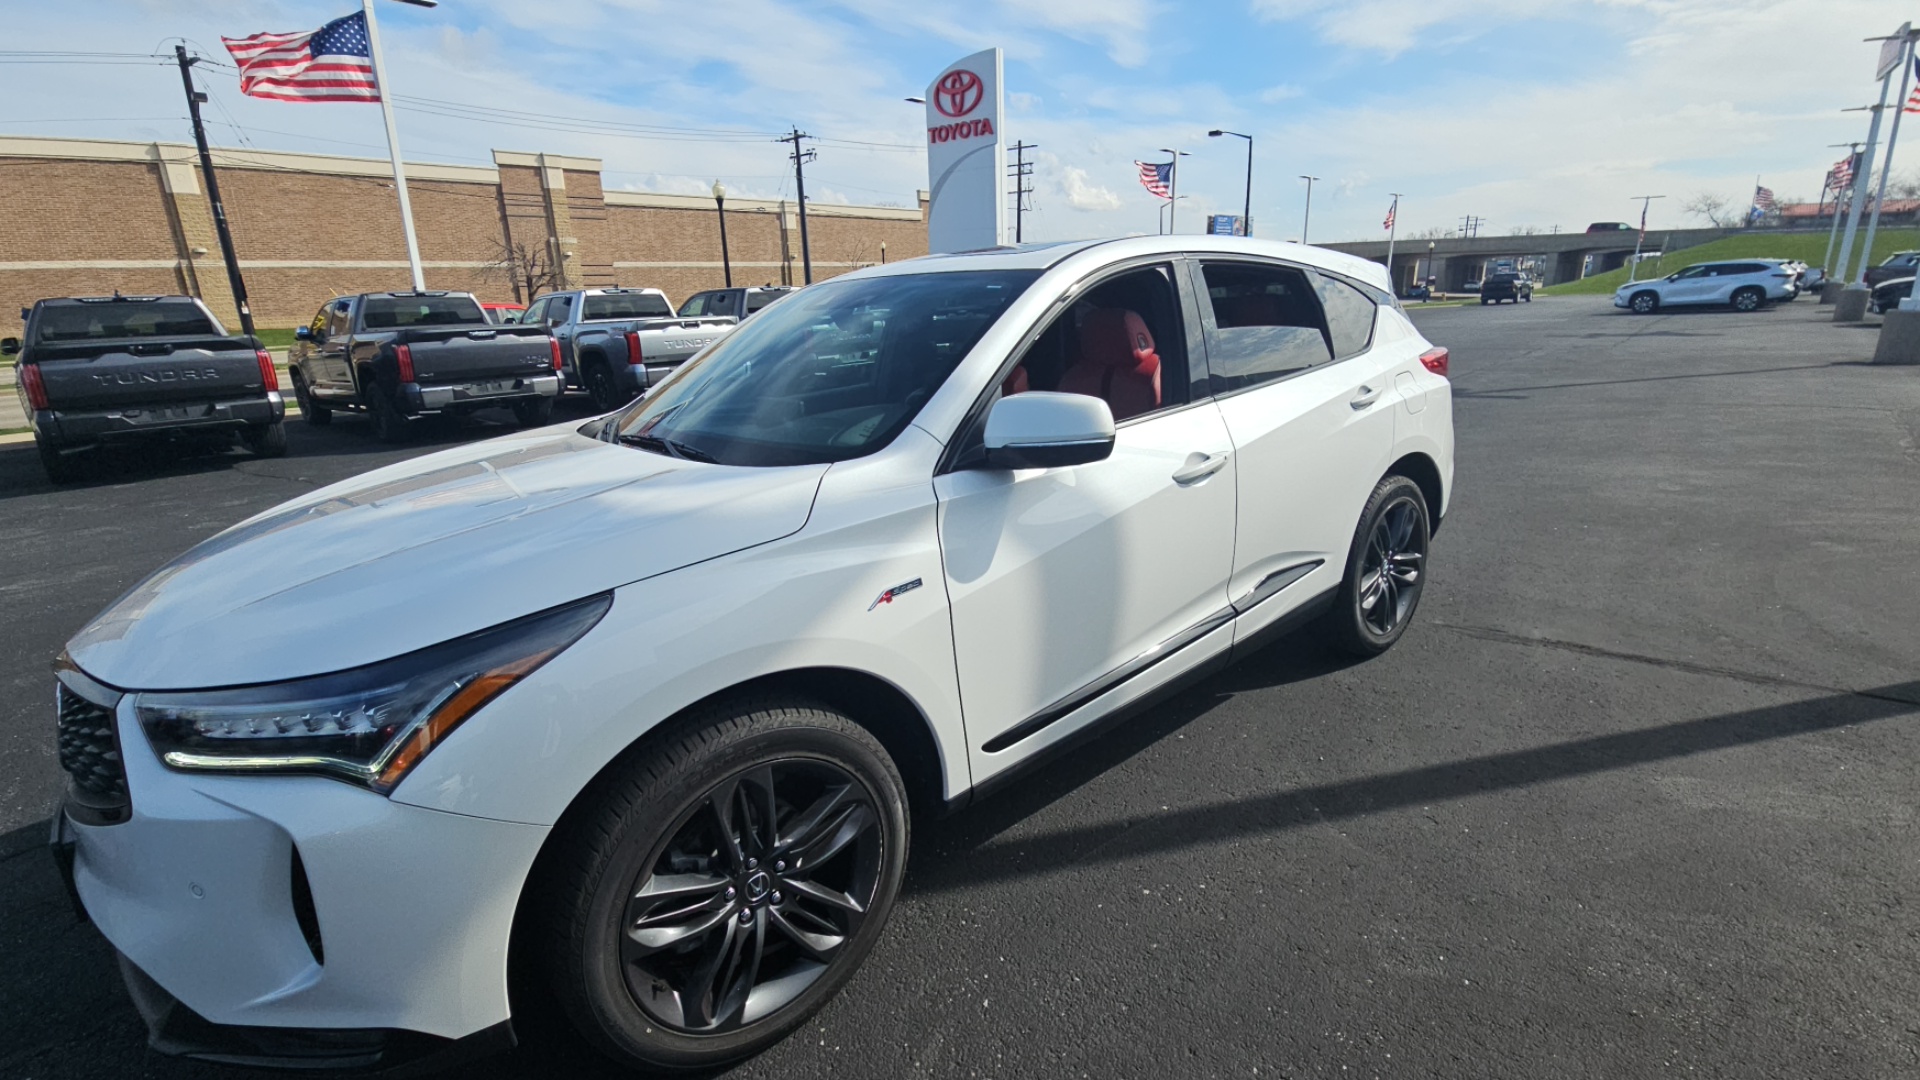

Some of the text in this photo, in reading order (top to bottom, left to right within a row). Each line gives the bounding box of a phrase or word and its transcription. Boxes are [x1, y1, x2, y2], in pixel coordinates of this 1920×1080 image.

[928, 118, 994, 144] TOYOTA
[664, 336, 718, 350] TUNDR
[93, 368, 220, 386] TUNDRA
